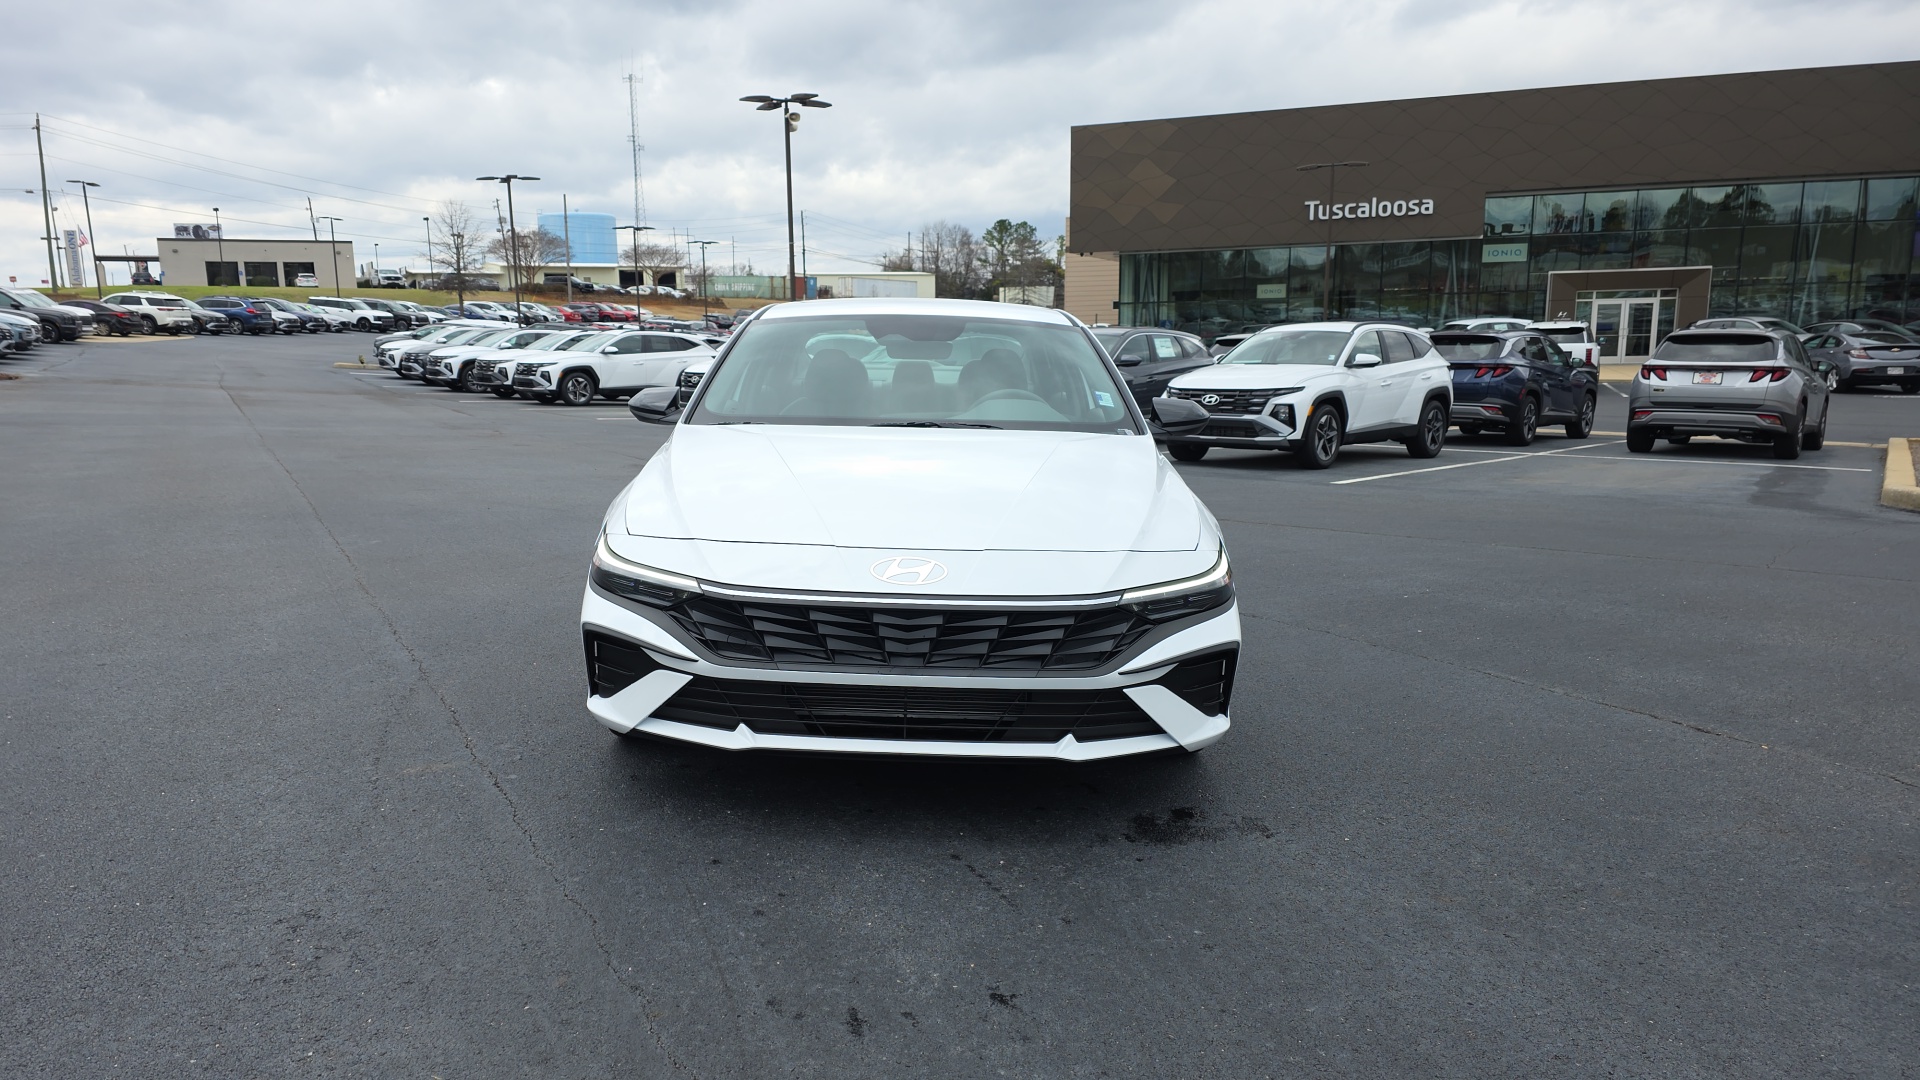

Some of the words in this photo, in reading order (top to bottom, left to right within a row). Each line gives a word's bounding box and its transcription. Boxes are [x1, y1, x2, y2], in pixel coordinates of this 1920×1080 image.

[1304, 197, 1434, 220] Tuscaloosa
[714, 283, 729, 291] CHINA
[731, 283, 756, 291] SHIPPING
